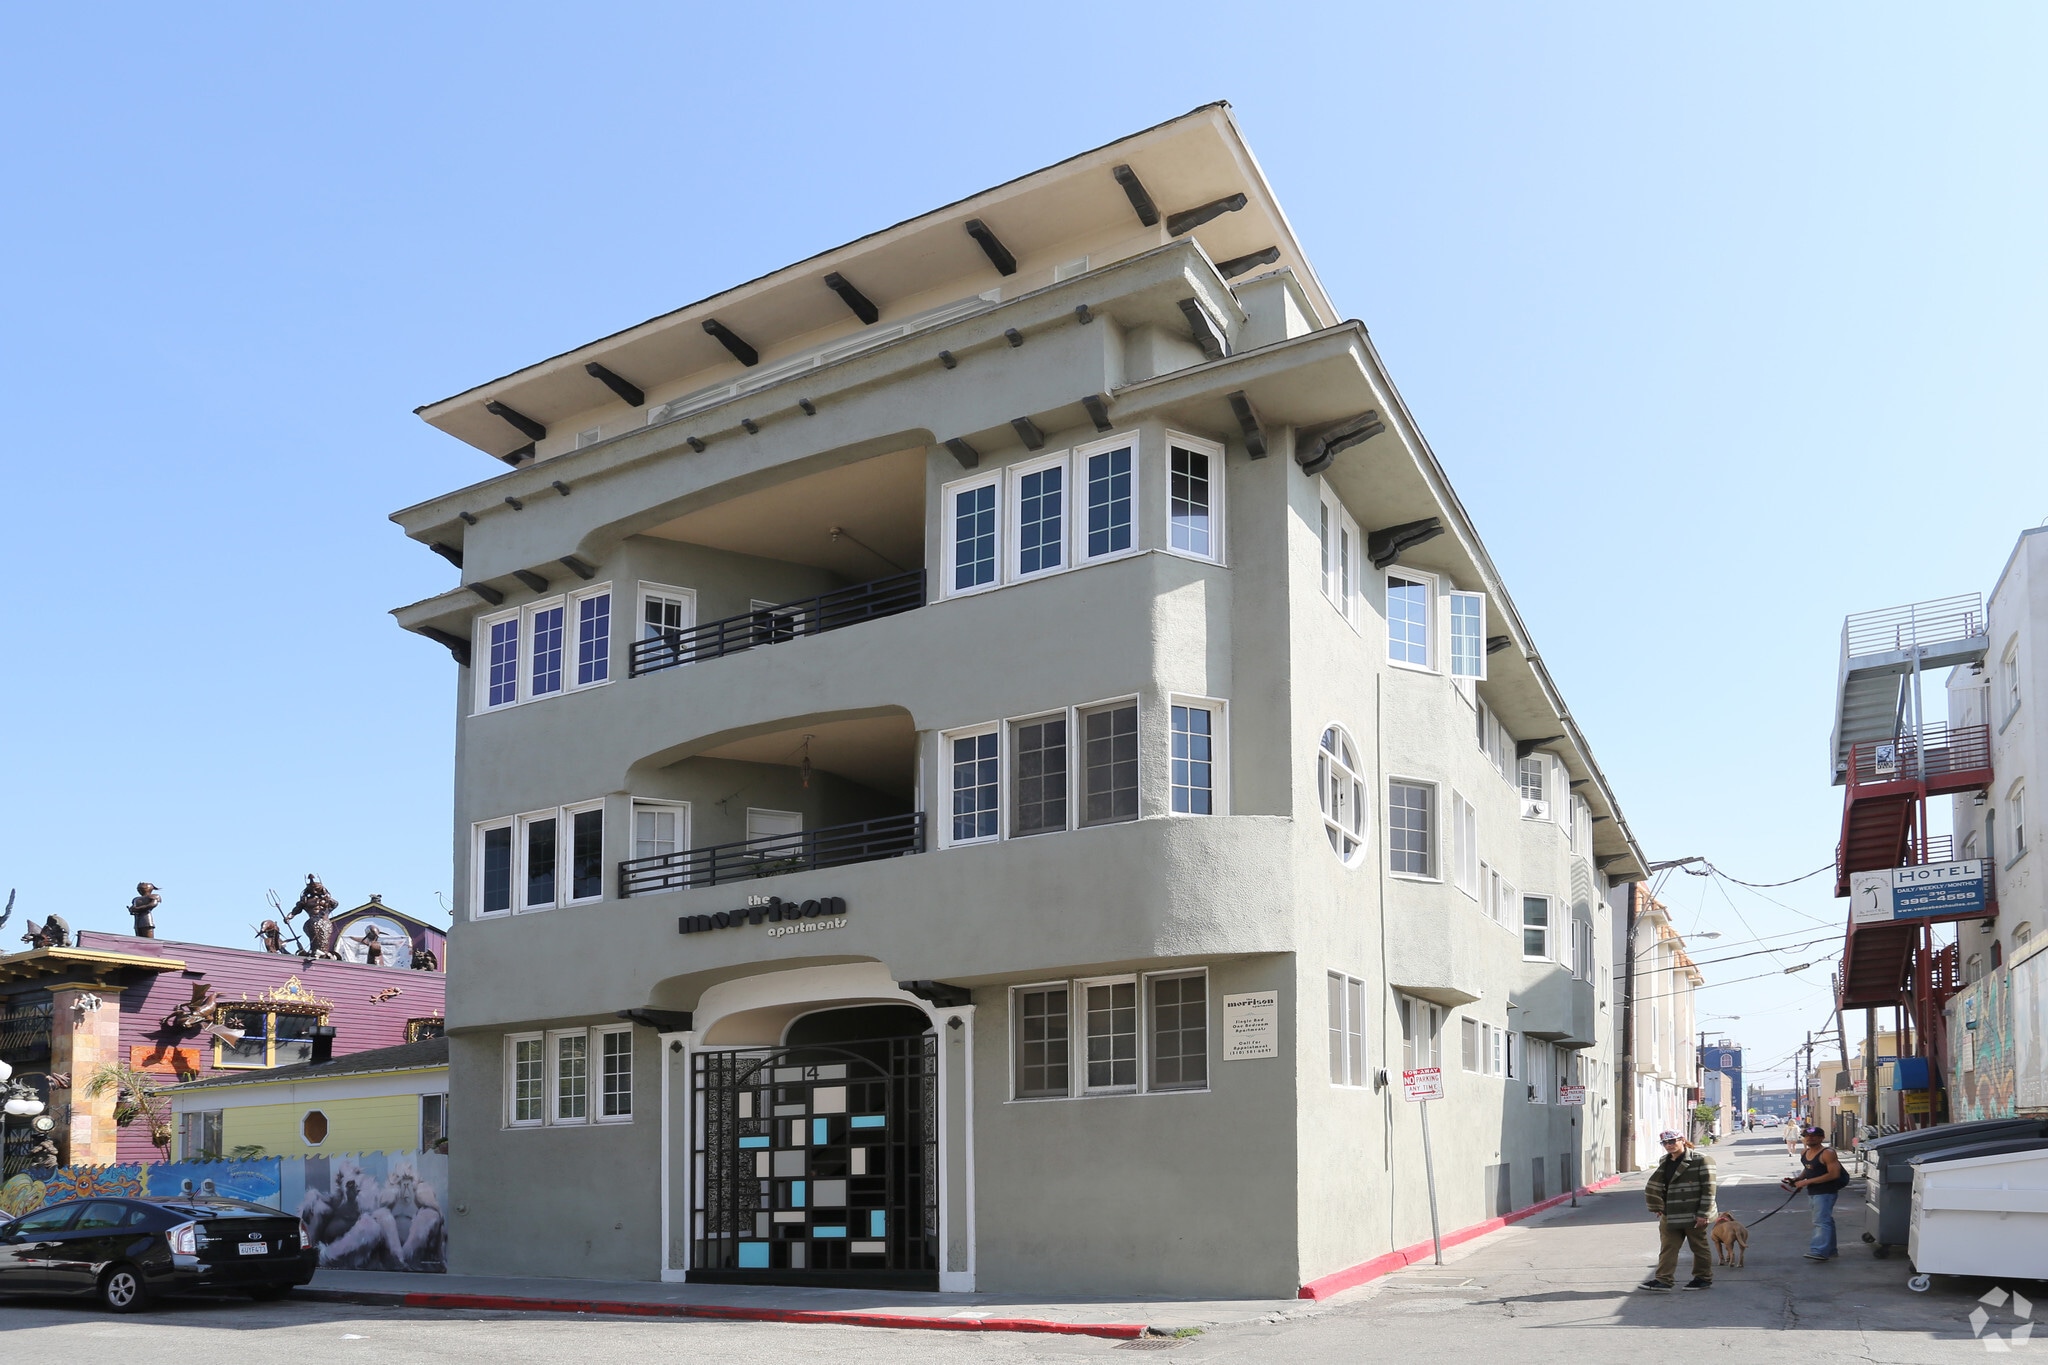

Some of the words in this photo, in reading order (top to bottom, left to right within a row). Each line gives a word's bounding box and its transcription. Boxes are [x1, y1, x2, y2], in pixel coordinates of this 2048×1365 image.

[1899, 865, 1975, 882] HOTEL
[748, 894, 770, 906] the
[1900, 891, 1976, 906] 396-4559
[678, 896, 847, 934] morrison
[767, 917, 848, 937] apartments
[1227, 998, 1273, 1007] morrison
[1404, 1076, 1415, 1085] NO
